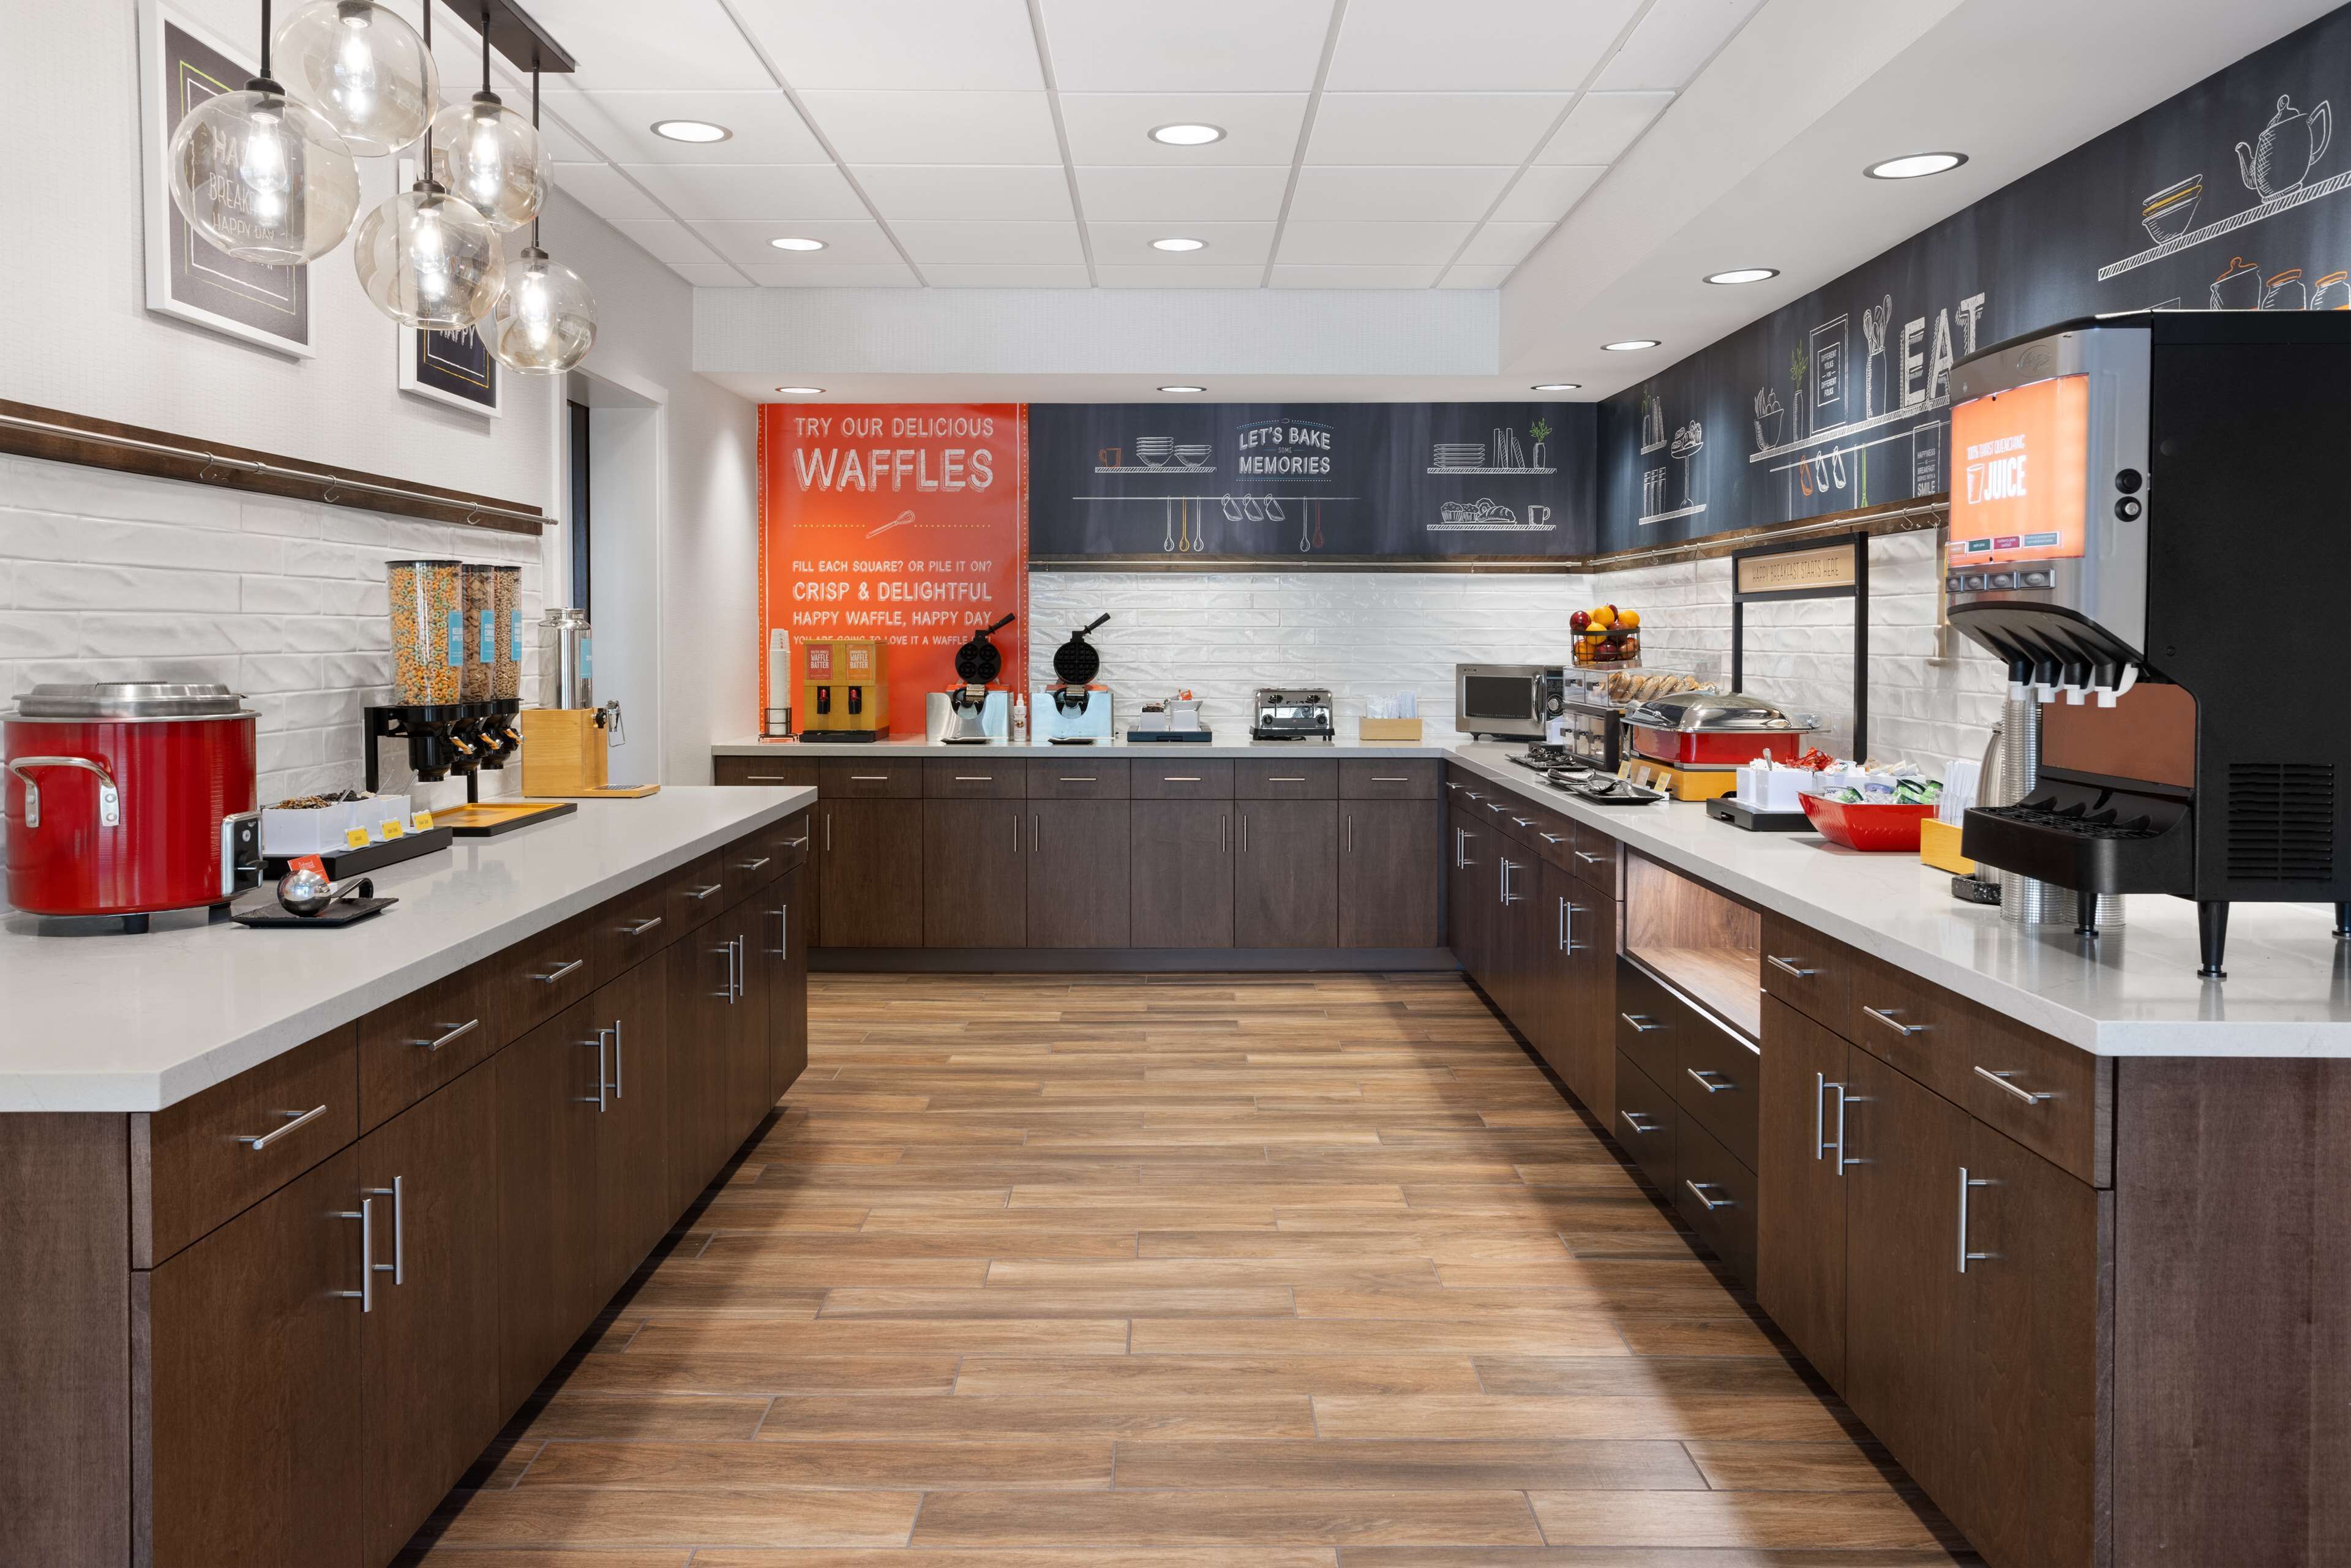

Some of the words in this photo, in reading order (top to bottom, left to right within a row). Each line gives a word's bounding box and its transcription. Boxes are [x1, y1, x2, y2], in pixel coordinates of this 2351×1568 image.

[212, 212, 250, 239] HAPPY
[440, 324, 475, 350] PPY
[1900, 292, 1985, 409] EAT
[794, 418, 832, 438] TRY
[841, 418, 883, 438] OUR
[891, 418, 994, 438] DELICIOUS
[1239, 427, 1283, 451] LET'S
[1289, 427, 1330, 450] BAKE
[793, 448, 994, 492] WAFFLES
[1239, 456, 1330, 475] MEMORIES
[1917, 481, 1935, 497] SMILE
[1984, 455, 2028, 501] JUICE
[793, 561, 814, 572] FILL
[819, 560, 848, 572] EACH
[852, 560, 904, 572] SQUARE?
[908, 561, 924, 572] OR
[929, 561, 952, 572] PILE
[956, 561, 966, 572] IT
[970, 561, 992, 572] ON?
[1753, 565, 1769, 583] HAPPY
[1771, 562, 1799, 582] BREAKFAST
[1801, 560, 1821, 579] STARTS
[1823, 558, 1839, 577] HERE
[793, 582, 850, 601] CRISP
[858, 582, 869, 601] &
[877, 582, 992, 602] DELIGHTFUL
[793, 611, 839, 626] HAPPY
[846, 611, 906, 626] WAFFLE,
[912, 611, 958, 626] HAPPY
[964, 611, 992, 626] DAY
[911, 636, 918, 645] IT
[923, 636, 929, 645] A
[933, 636, 967, 645] WAFFLE
